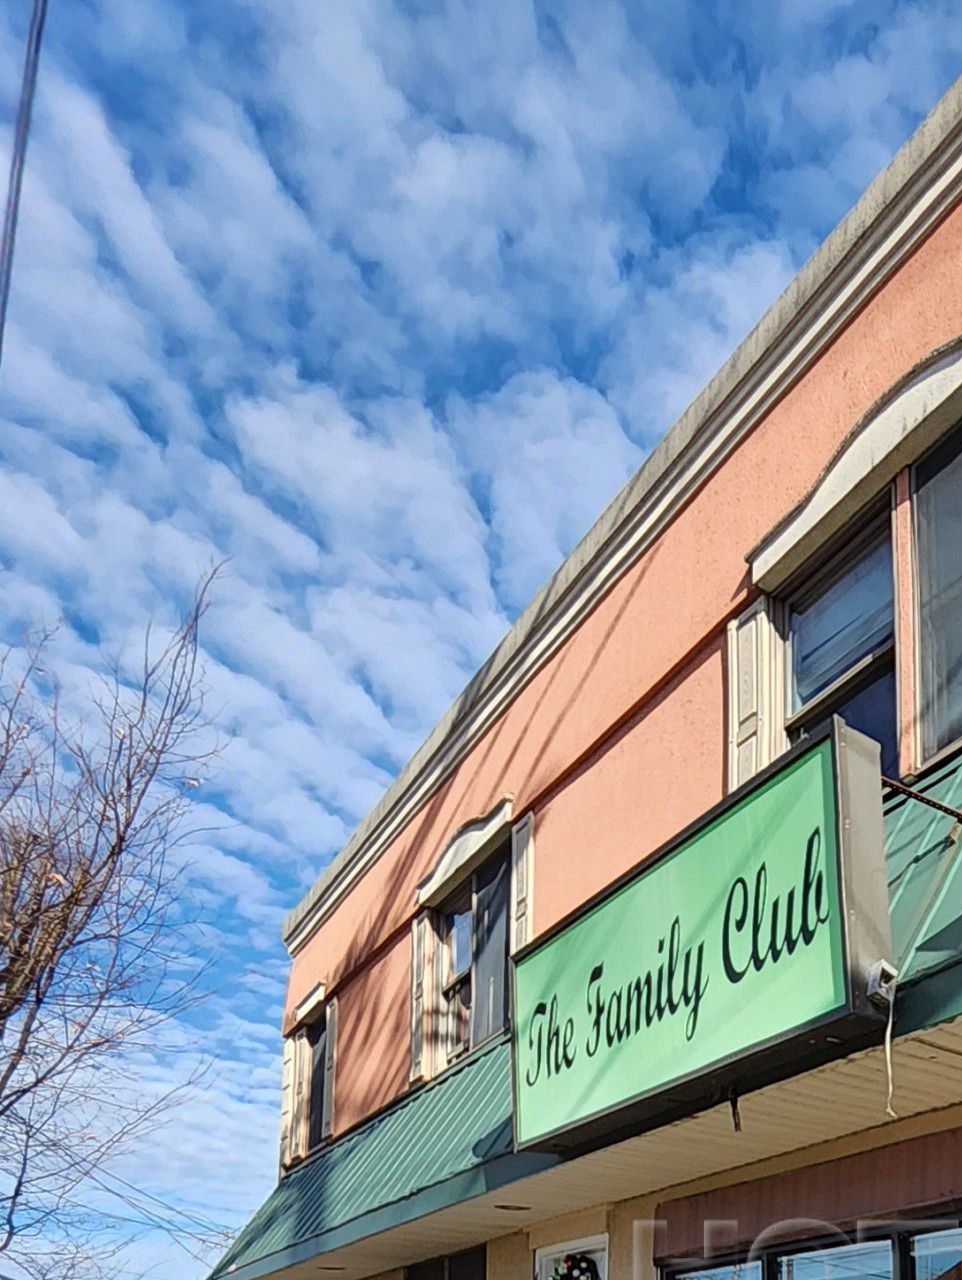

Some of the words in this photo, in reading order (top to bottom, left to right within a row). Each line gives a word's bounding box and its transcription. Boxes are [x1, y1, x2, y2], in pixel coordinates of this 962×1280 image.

[526, 992, 577, 1088] The
[586, 915, 709, 1042] Family
[722, 825, 830, 984] Club
